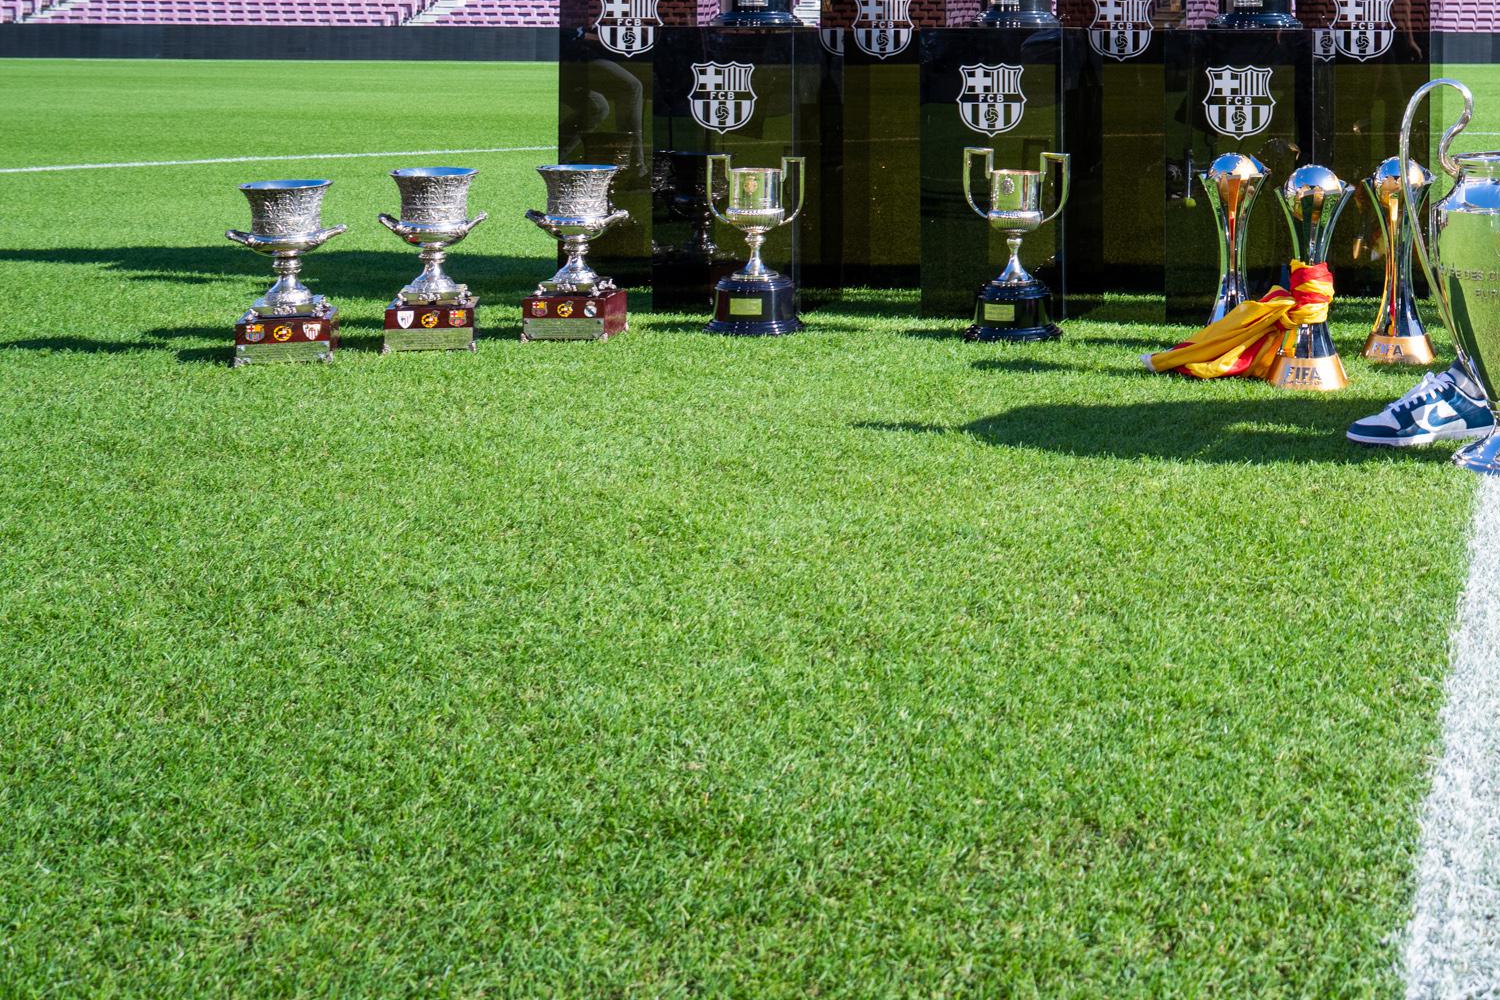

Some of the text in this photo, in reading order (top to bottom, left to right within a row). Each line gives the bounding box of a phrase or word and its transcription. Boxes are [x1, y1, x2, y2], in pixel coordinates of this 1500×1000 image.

[617, 19, 642, 27] FCB
[1110, 22, 1133, 30] FCB
[1351, 22, 1374, 30] FCB
[710, 91, 735, 100] FCB
[979, 94, 1004, 102] FCB
[1226, 96, 1252, 105] FCB
[1373, 342, 1403, 356] FIFA
[1285, 365, 1322, 381] FIFA
